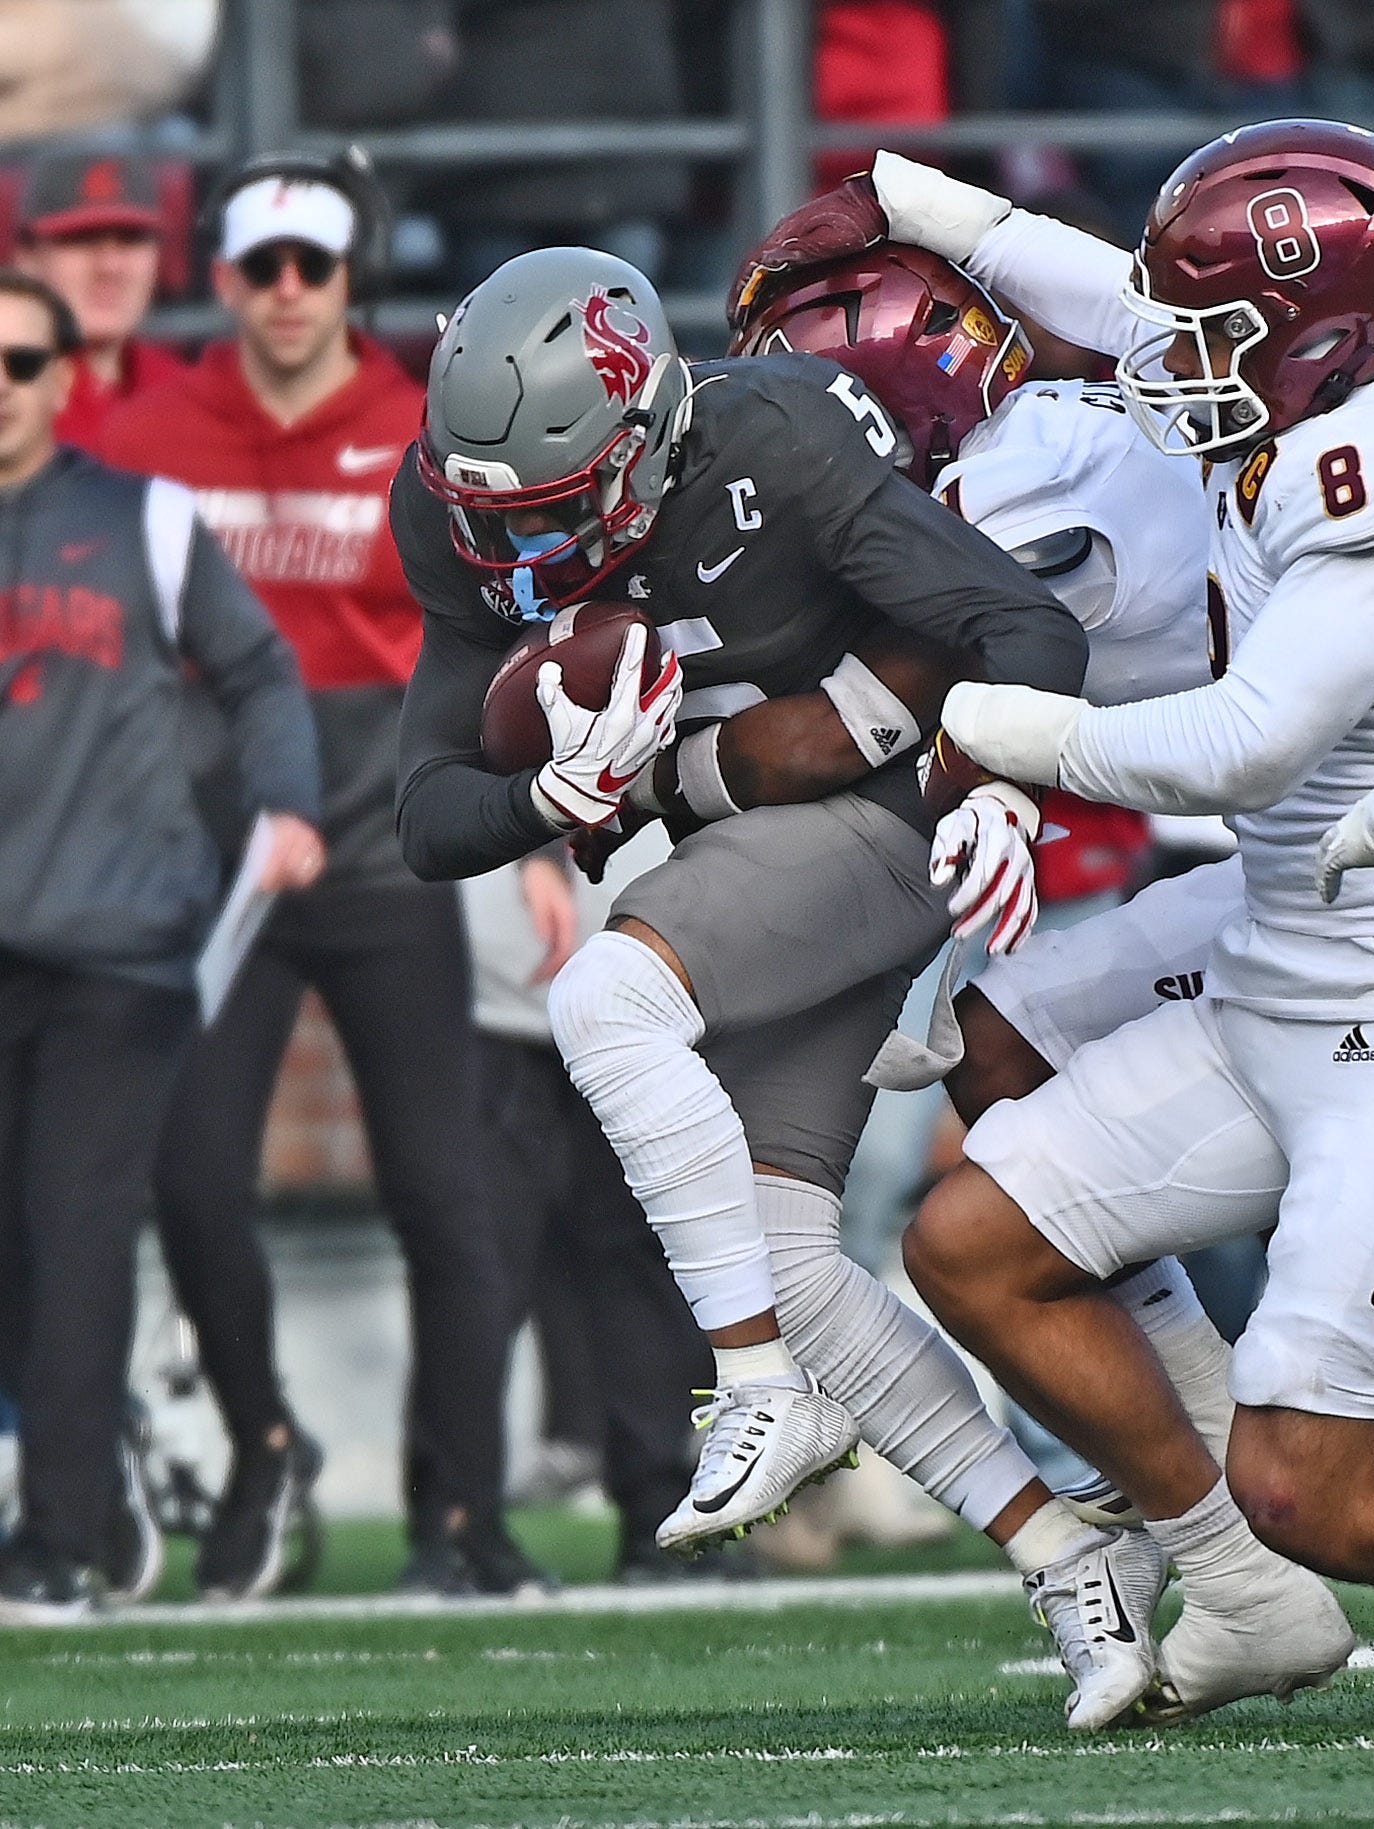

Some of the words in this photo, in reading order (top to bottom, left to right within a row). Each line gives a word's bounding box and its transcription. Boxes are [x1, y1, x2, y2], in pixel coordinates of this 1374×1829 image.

[1246, 187, 1321, 281] 8
[825, 372, 898, 458] 5
[724, 477, 764, 532] C
[1242, 450, 1270, 500] C
[1316, 441, 1370, 522] 8
[1153, 970, 1206, 1001] SU
